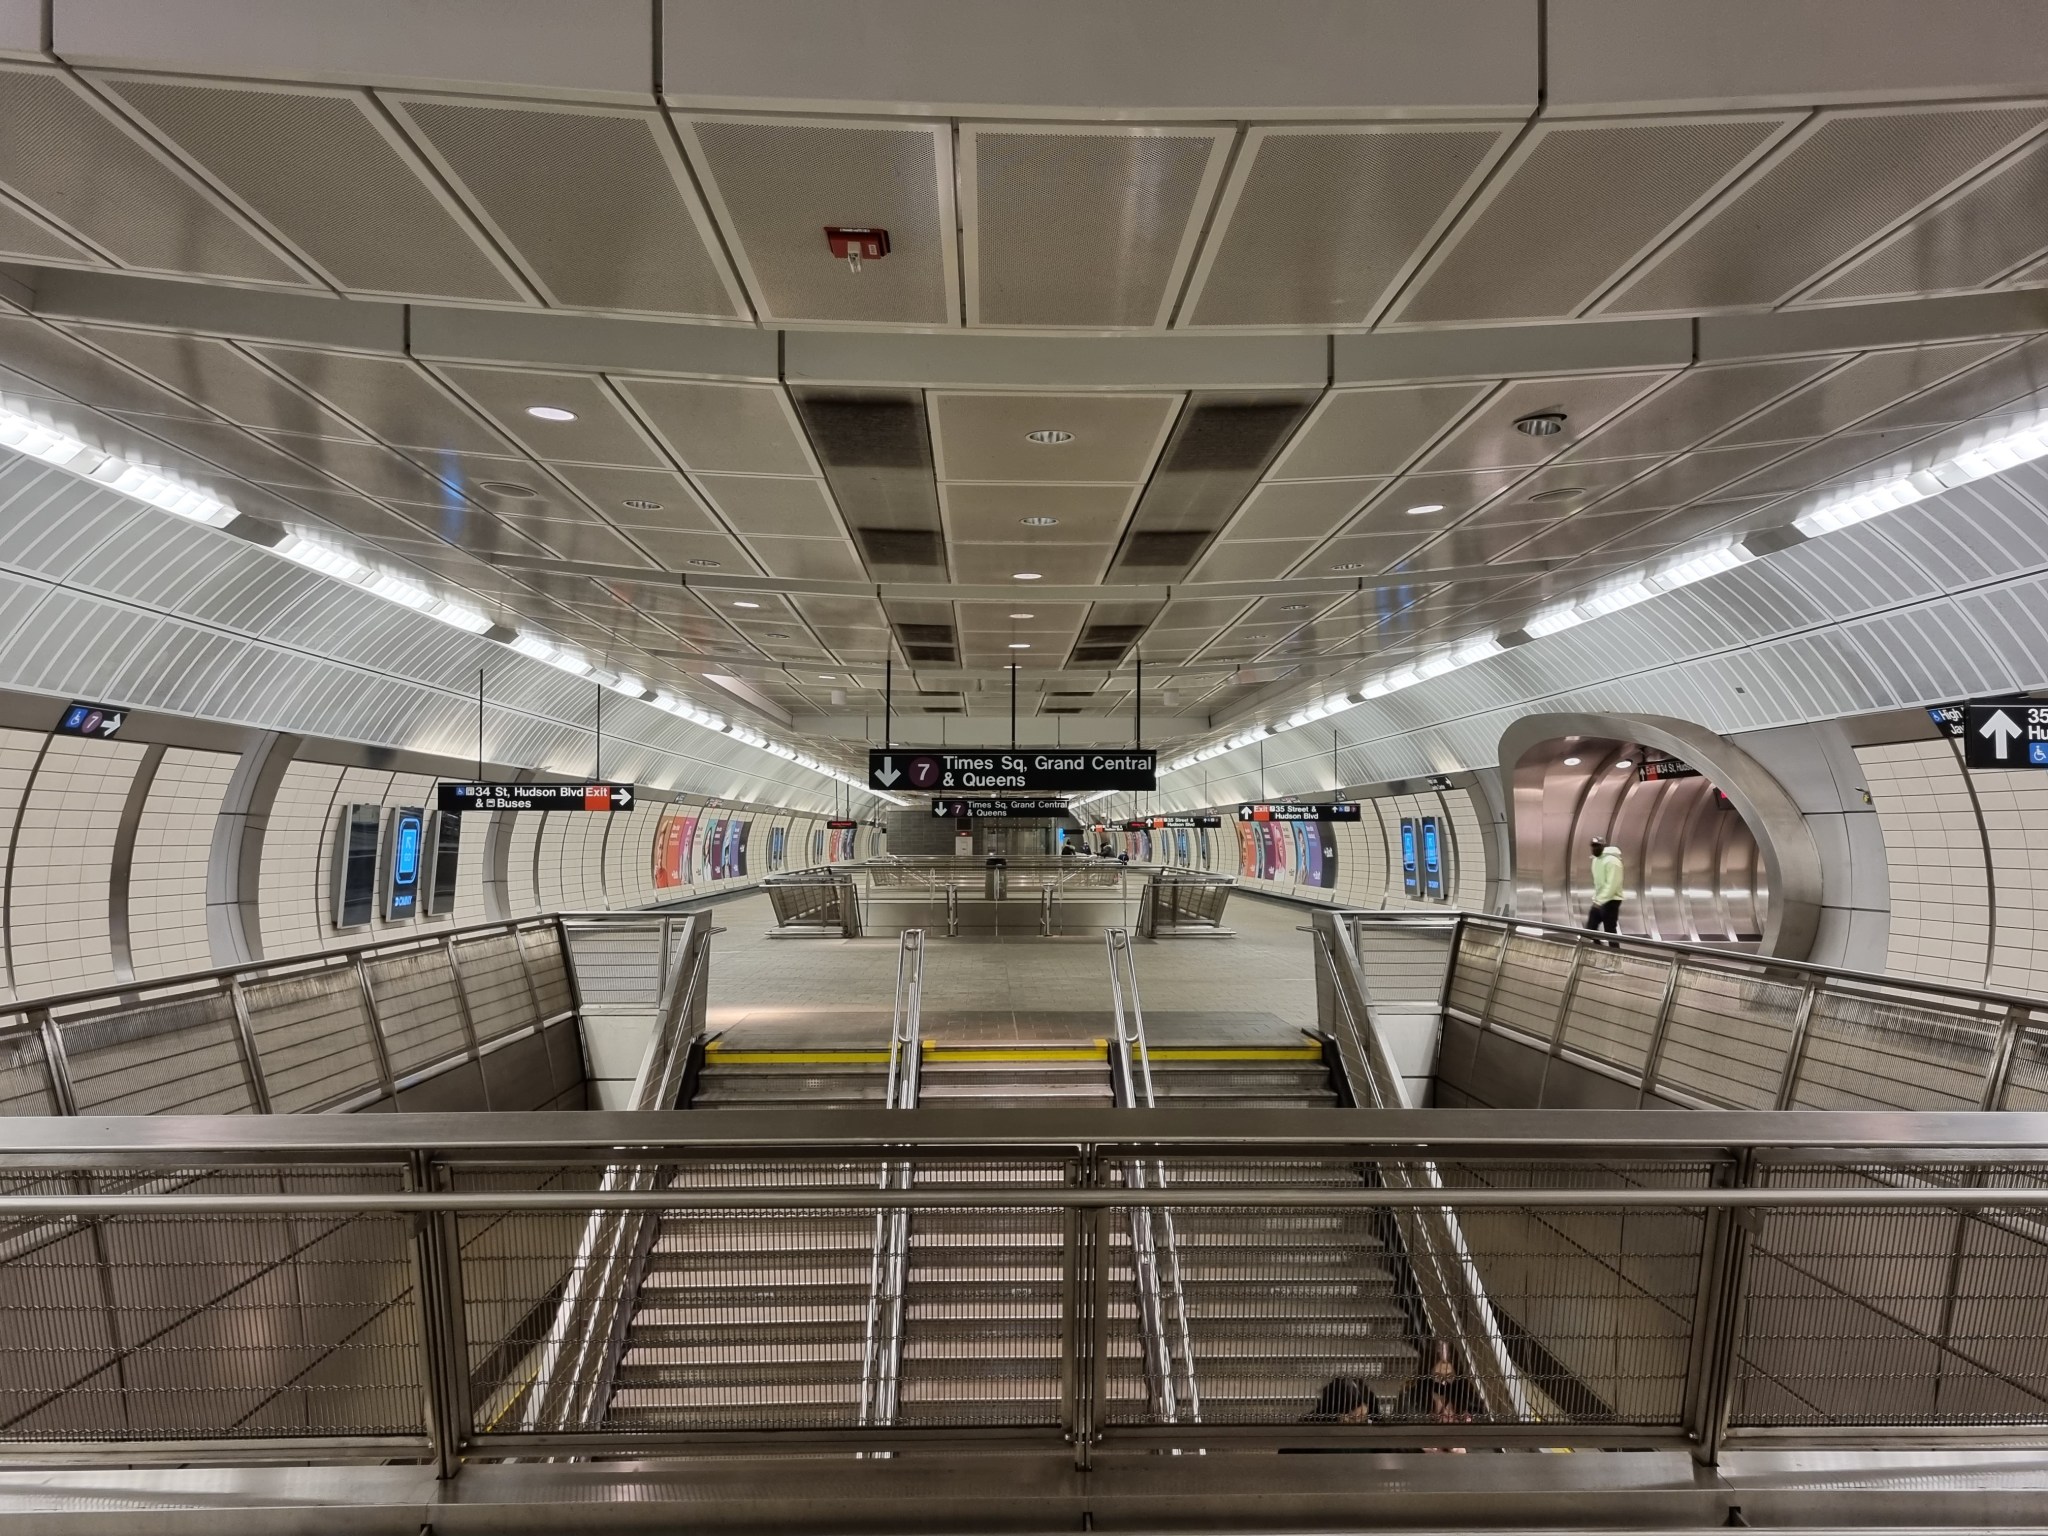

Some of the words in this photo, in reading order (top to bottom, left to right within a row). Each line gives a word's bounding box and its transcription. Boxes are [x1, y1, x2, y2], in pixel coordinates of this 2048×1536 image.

[2028, 708, 2048, 723] 35
[942, 755, 993, 770] Times
[1001, 755, 1028, 773] Sq,
[1034, 755, 1085, 770] Grand
[1091, 755, 1152, 770] Central
[917, 763, 930, 781] 7
[942, 771, 954, 787] &
[962, 772, 1026, 787] Queens
[475, 787, 490, 797] 34
[495, 786, 510, 799] St,
[514, 786, 556, 797] Hudson
[560, 786, 584, 797] Blvd
[586, 786, 608, 797] Exit
[475, 799, 484, 808] &
[497, 798, 531, 808] Buses
[995, 801, 1007, 810] Sq,
[967, 809, 973, 817] &
[976, 809, 1007, 817] Queens
